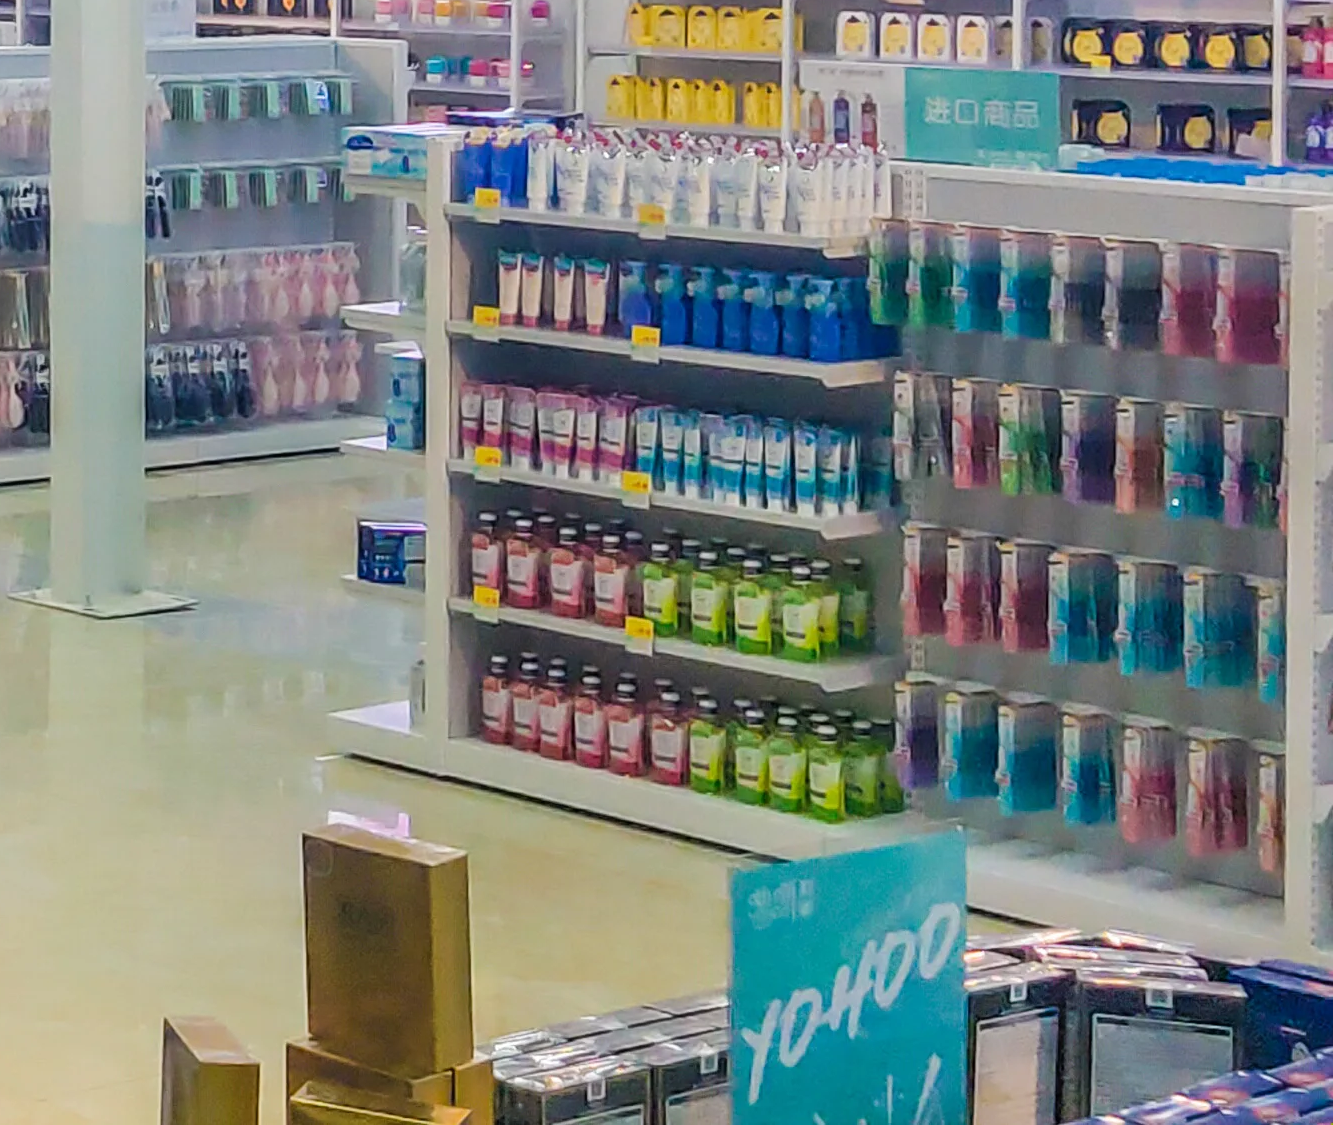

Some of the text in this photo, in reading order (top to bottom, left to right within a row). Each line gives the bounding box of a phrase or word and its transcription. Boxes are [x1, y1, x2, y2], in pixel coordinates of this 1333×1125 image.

[924, 95, 1040, 129] 进口商品
[740, 901, 961, 1106] YOHOO
